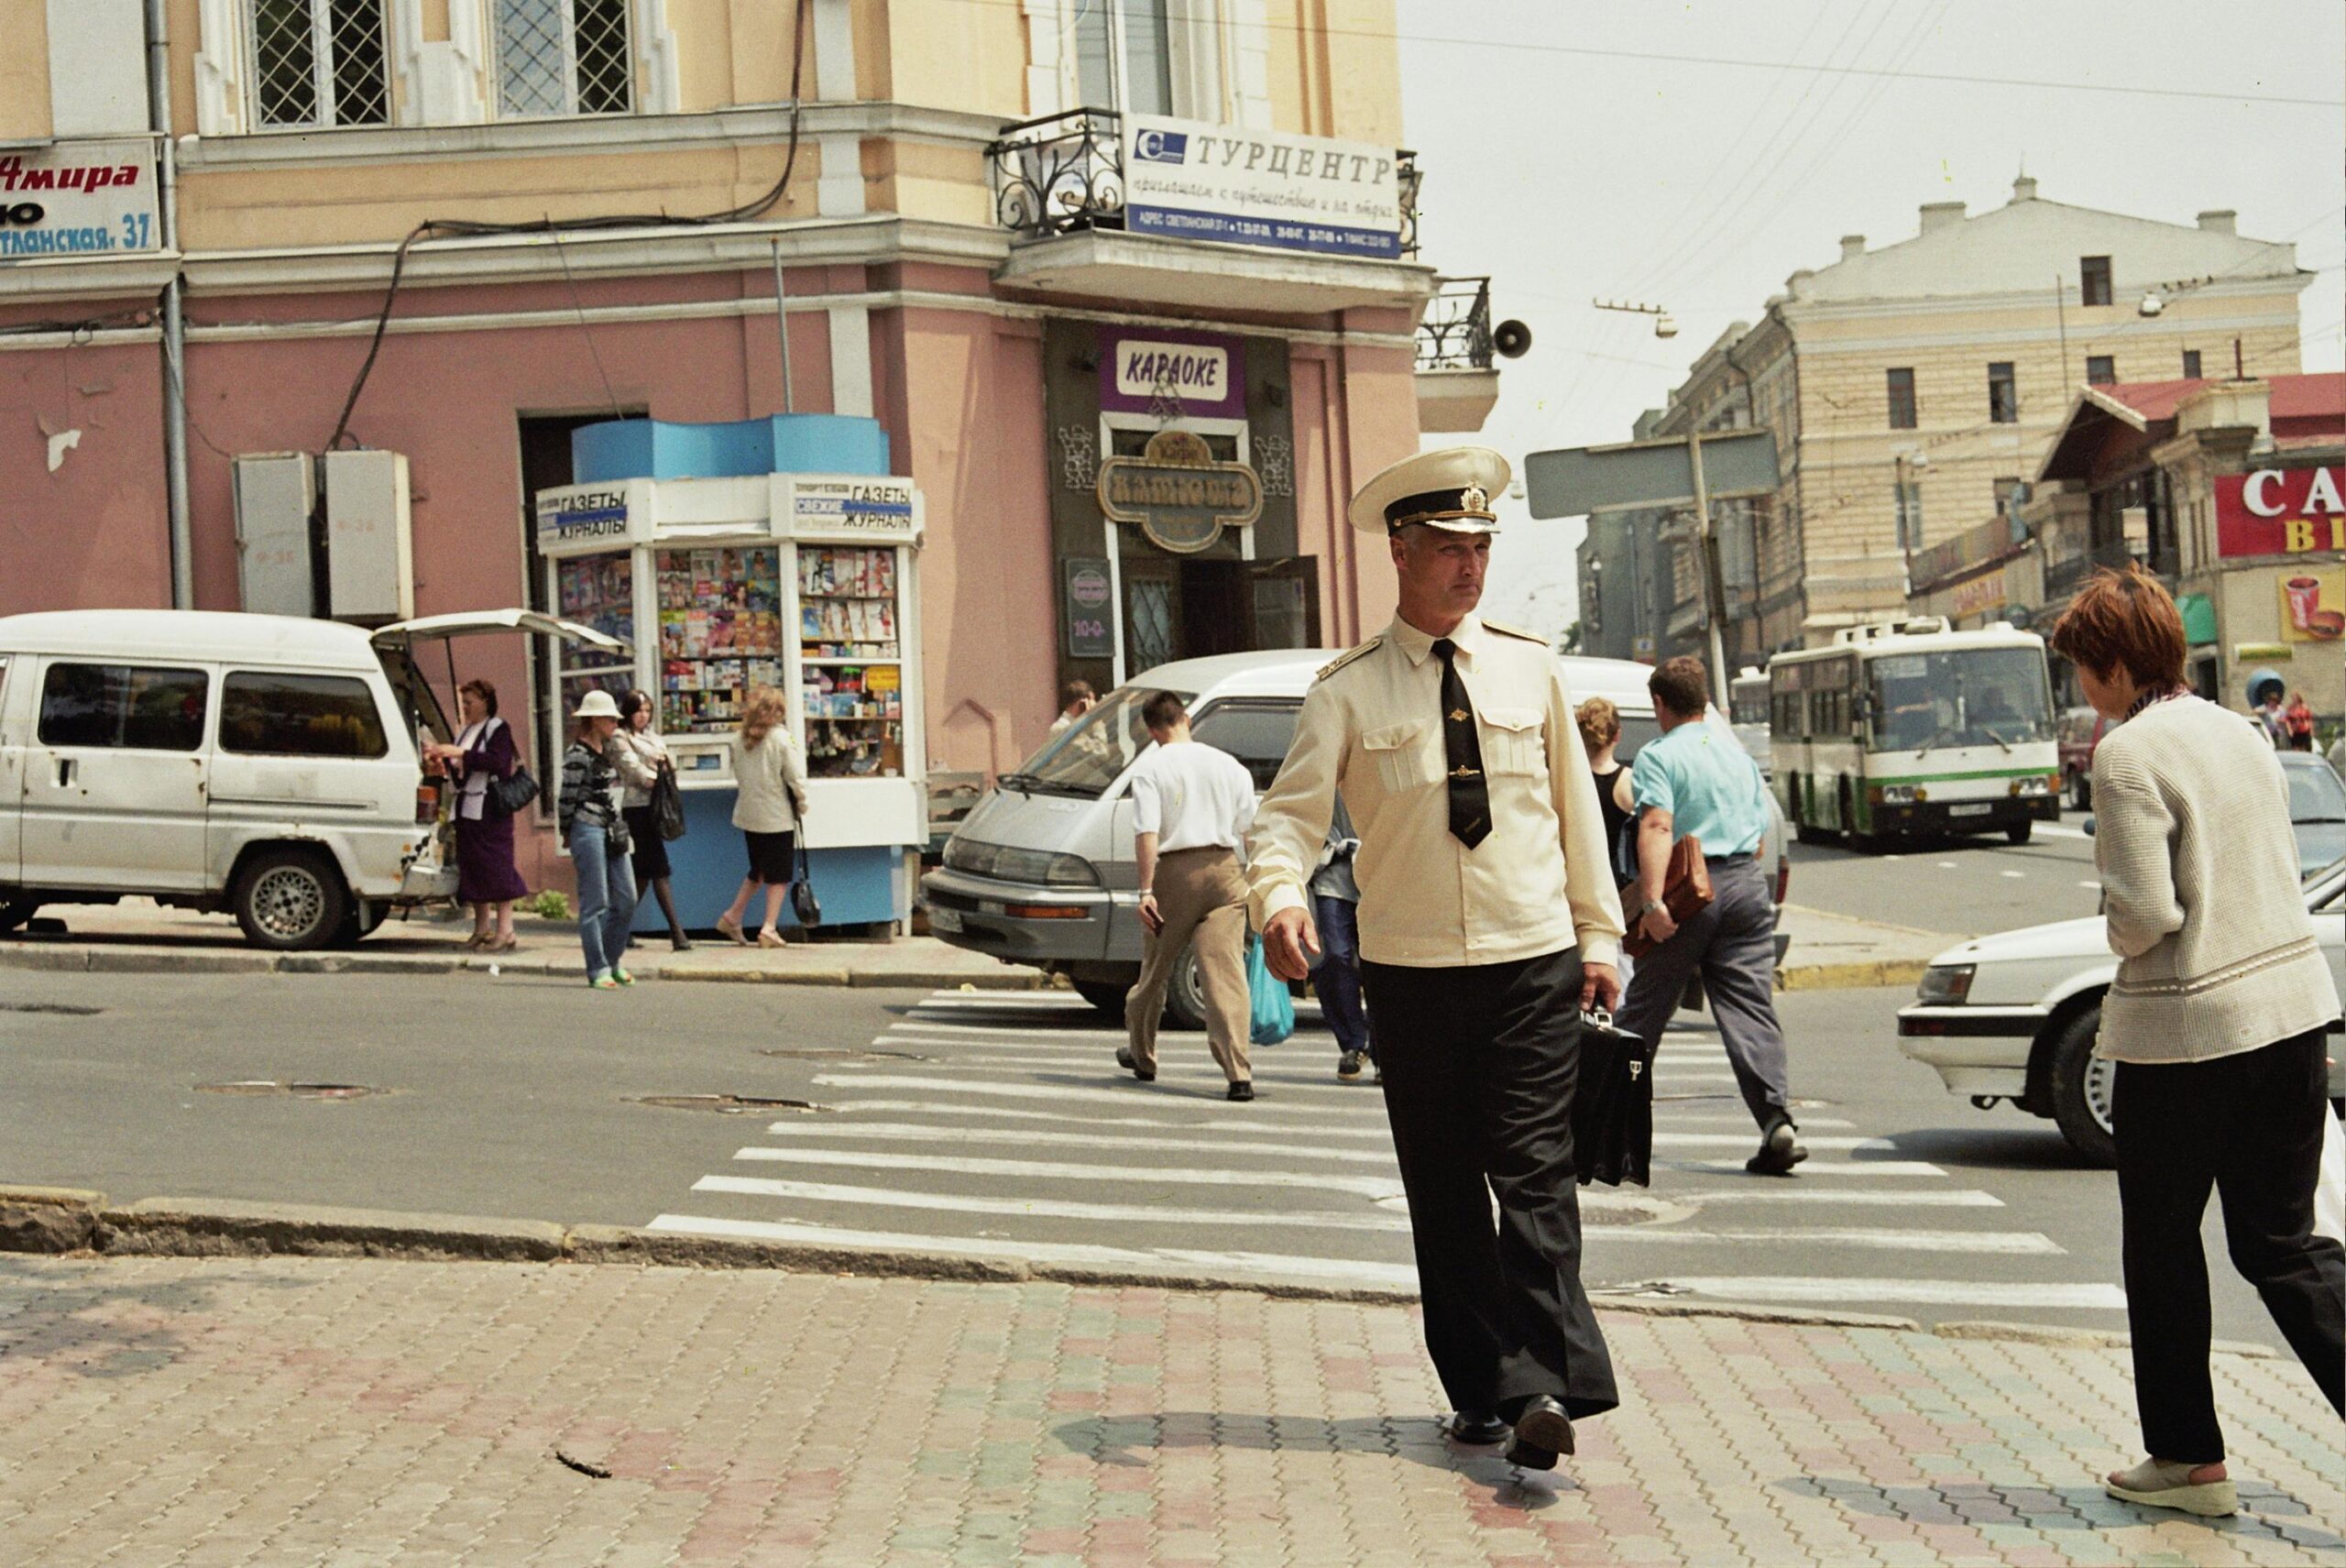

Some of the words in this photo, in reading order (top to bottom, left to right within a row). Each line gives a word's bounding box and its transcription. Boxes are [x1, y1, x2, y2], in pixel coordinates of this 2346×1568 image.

[1198, 135, 1390, 184] ТУРЦЕНТР
[122, 214, 150, 248] 37
[1125, 352, 1219, 388] КАРАОКЕ
[561, 491, 626, 513] ГАЗЕТЫ
[851, 485, 910, 504] ГАЗЕТЫ
[558, 519, 627, 540] ЖУРНАЛЫ
